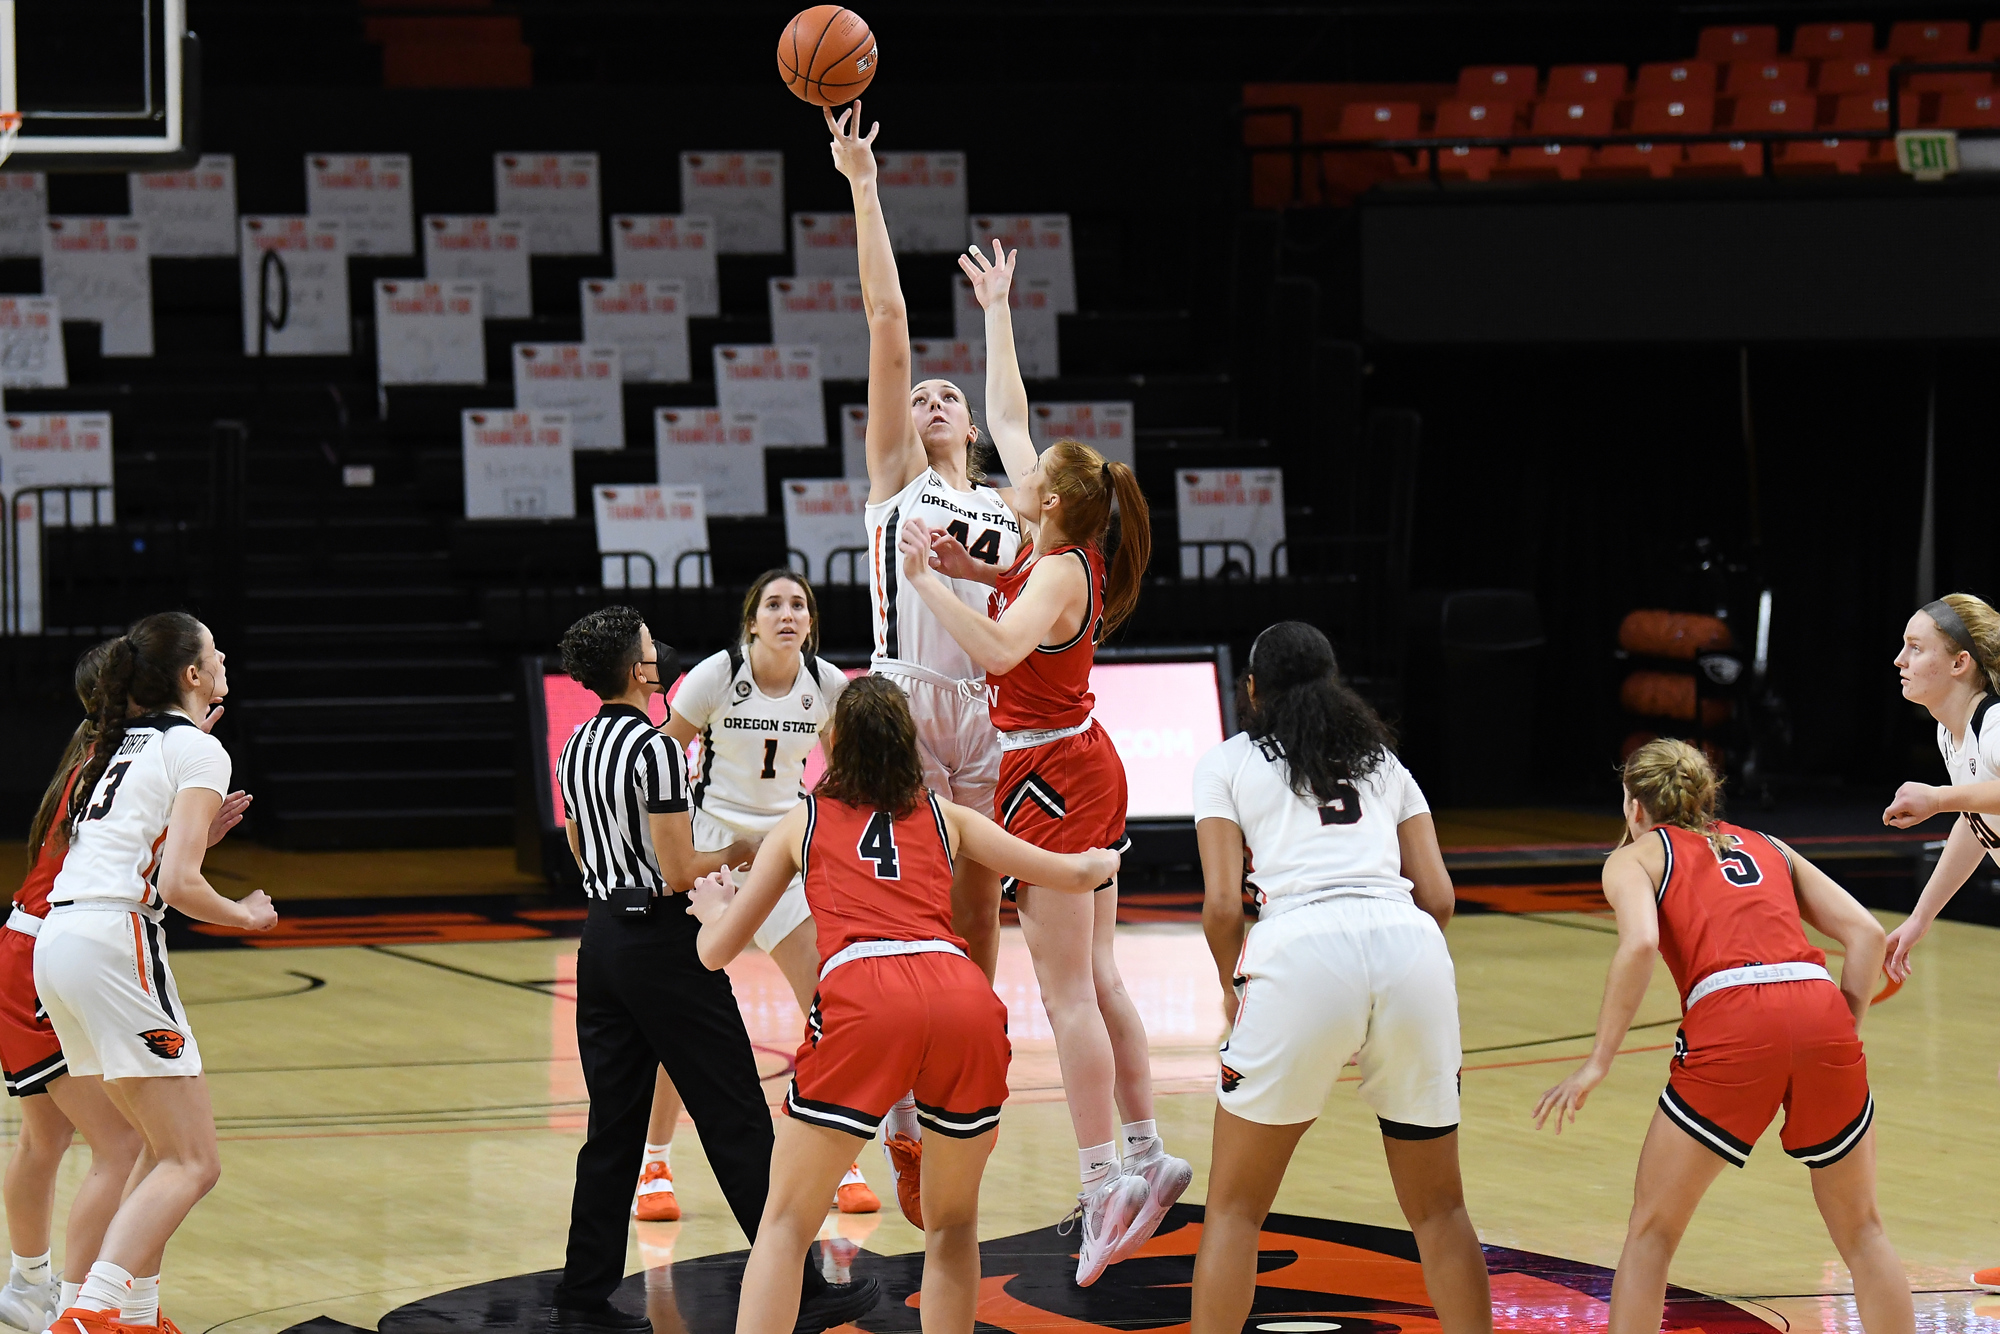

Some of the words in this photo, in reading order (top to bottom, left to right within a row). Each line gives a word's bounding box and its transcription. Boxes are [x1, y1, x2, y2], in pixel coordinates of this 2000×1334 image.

[1905, 136, 1949, 172] EXIT
[921, 493, 978, 521] OREGON
[982, 512, 1019, 534] STATE
[946, 519, 1001, 565] 44
[723, 717, 779, 731] OREGON
[782, 721, 817, 733] STATE
[760, 738, 778, 779] 1
[857, 811, 900, 880] 4
[1707, 834, 1763, 887] 5
